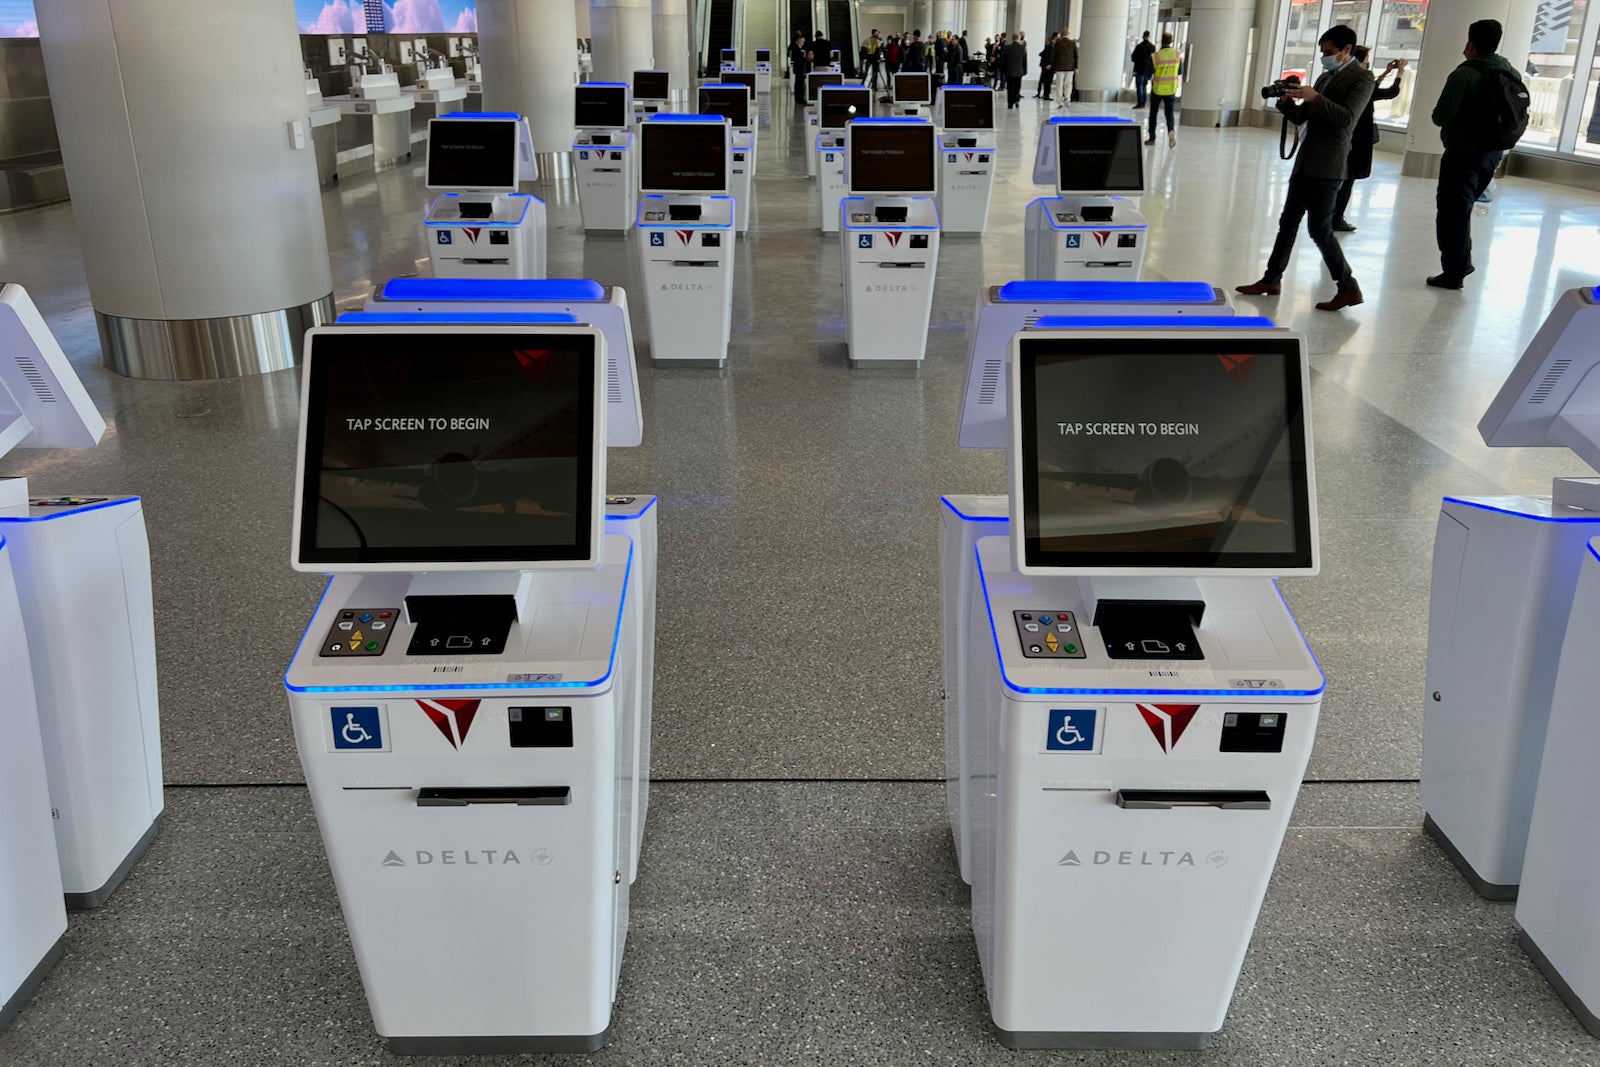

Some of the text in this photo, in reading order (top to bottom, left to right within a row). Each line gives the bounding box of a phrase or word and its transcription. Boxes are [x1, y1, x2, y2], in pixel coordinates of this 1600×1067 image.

[346, 417, 490, 430] TAP SCREEN TO BEGIN
[1057, 422, 1199, 435] TAP SCREEN TO BEGIN
[416, 850, 521, 865] DELTA
[1093, 850, 1195, 865] DELTA
